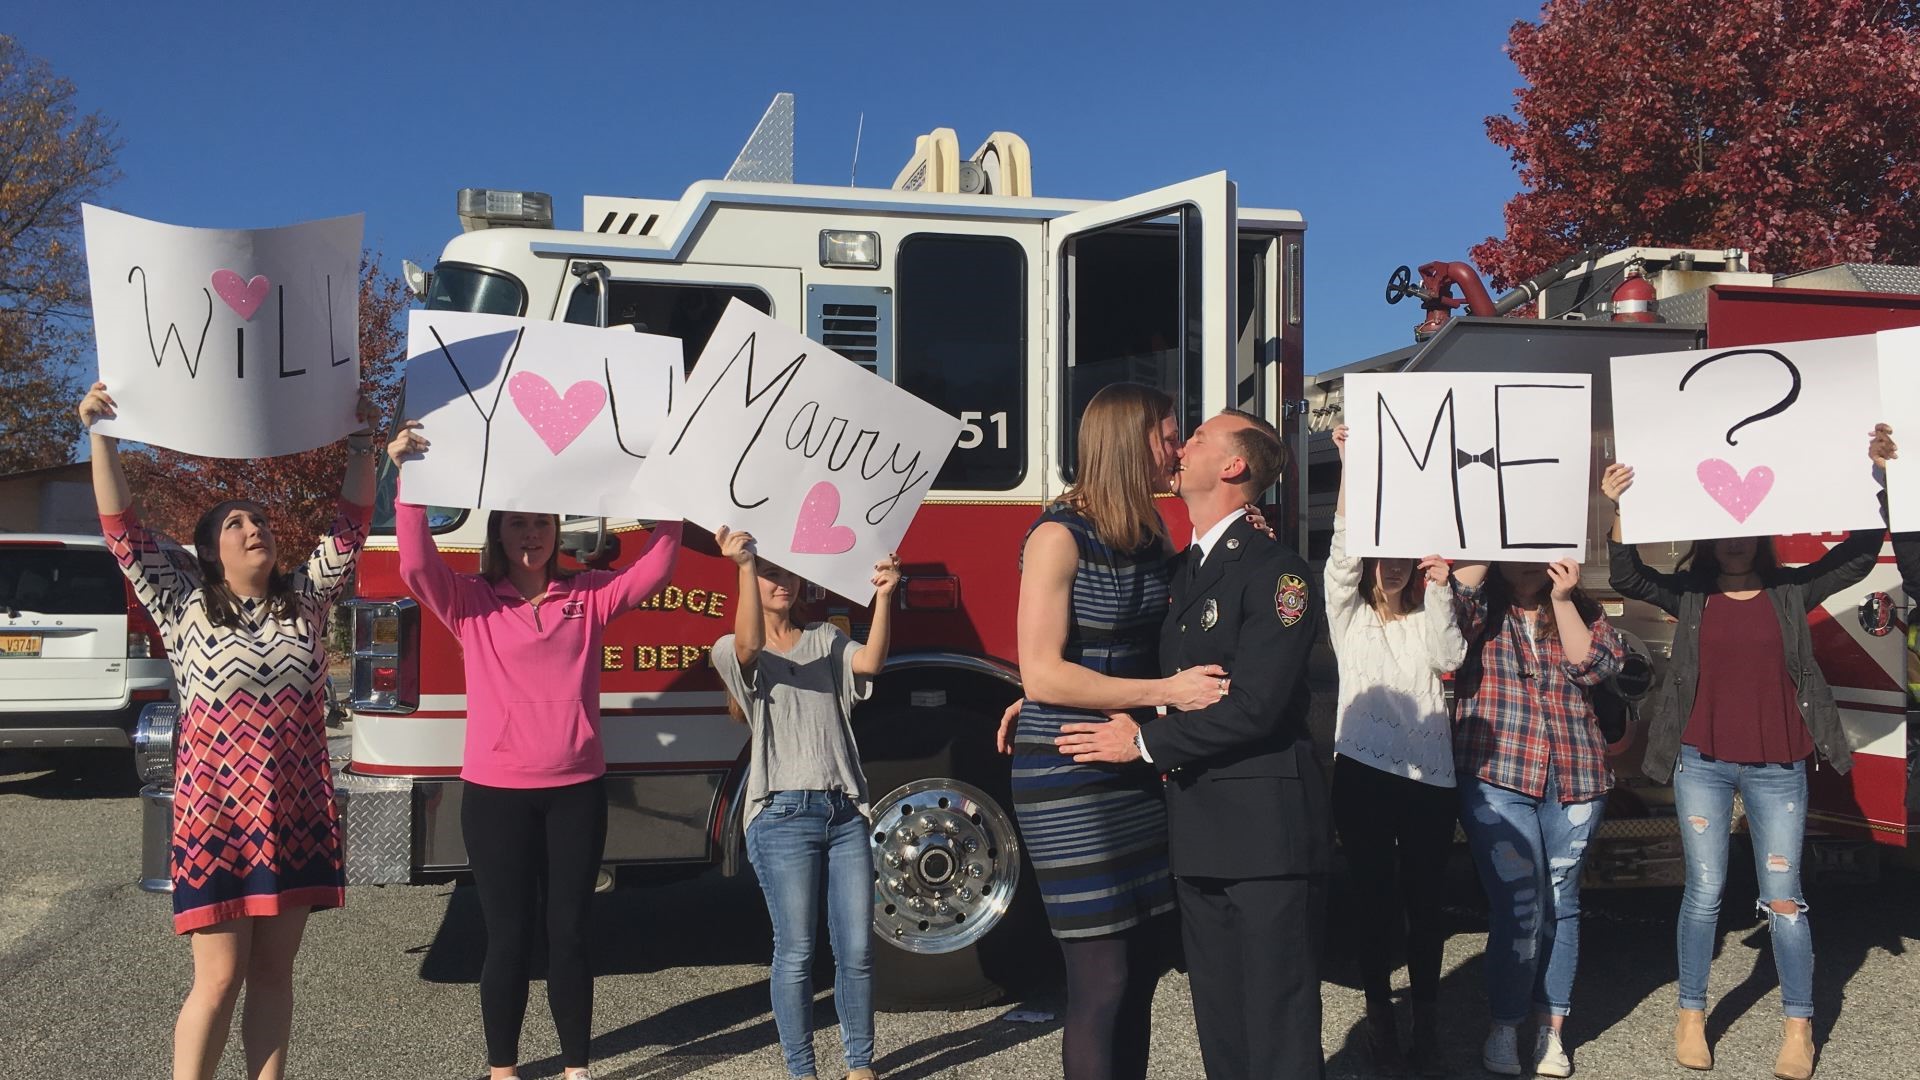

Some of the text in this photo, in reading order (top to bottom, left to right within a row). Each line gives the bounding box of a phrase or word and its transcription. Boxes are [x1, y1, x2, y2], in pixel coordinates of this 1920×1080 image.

[669, 331, 928, 525] Marry
[957, 411, 1007, 449] 51
[1373, 383, 1585, 550] ME
[641, 585, 728, 617] IDGE
